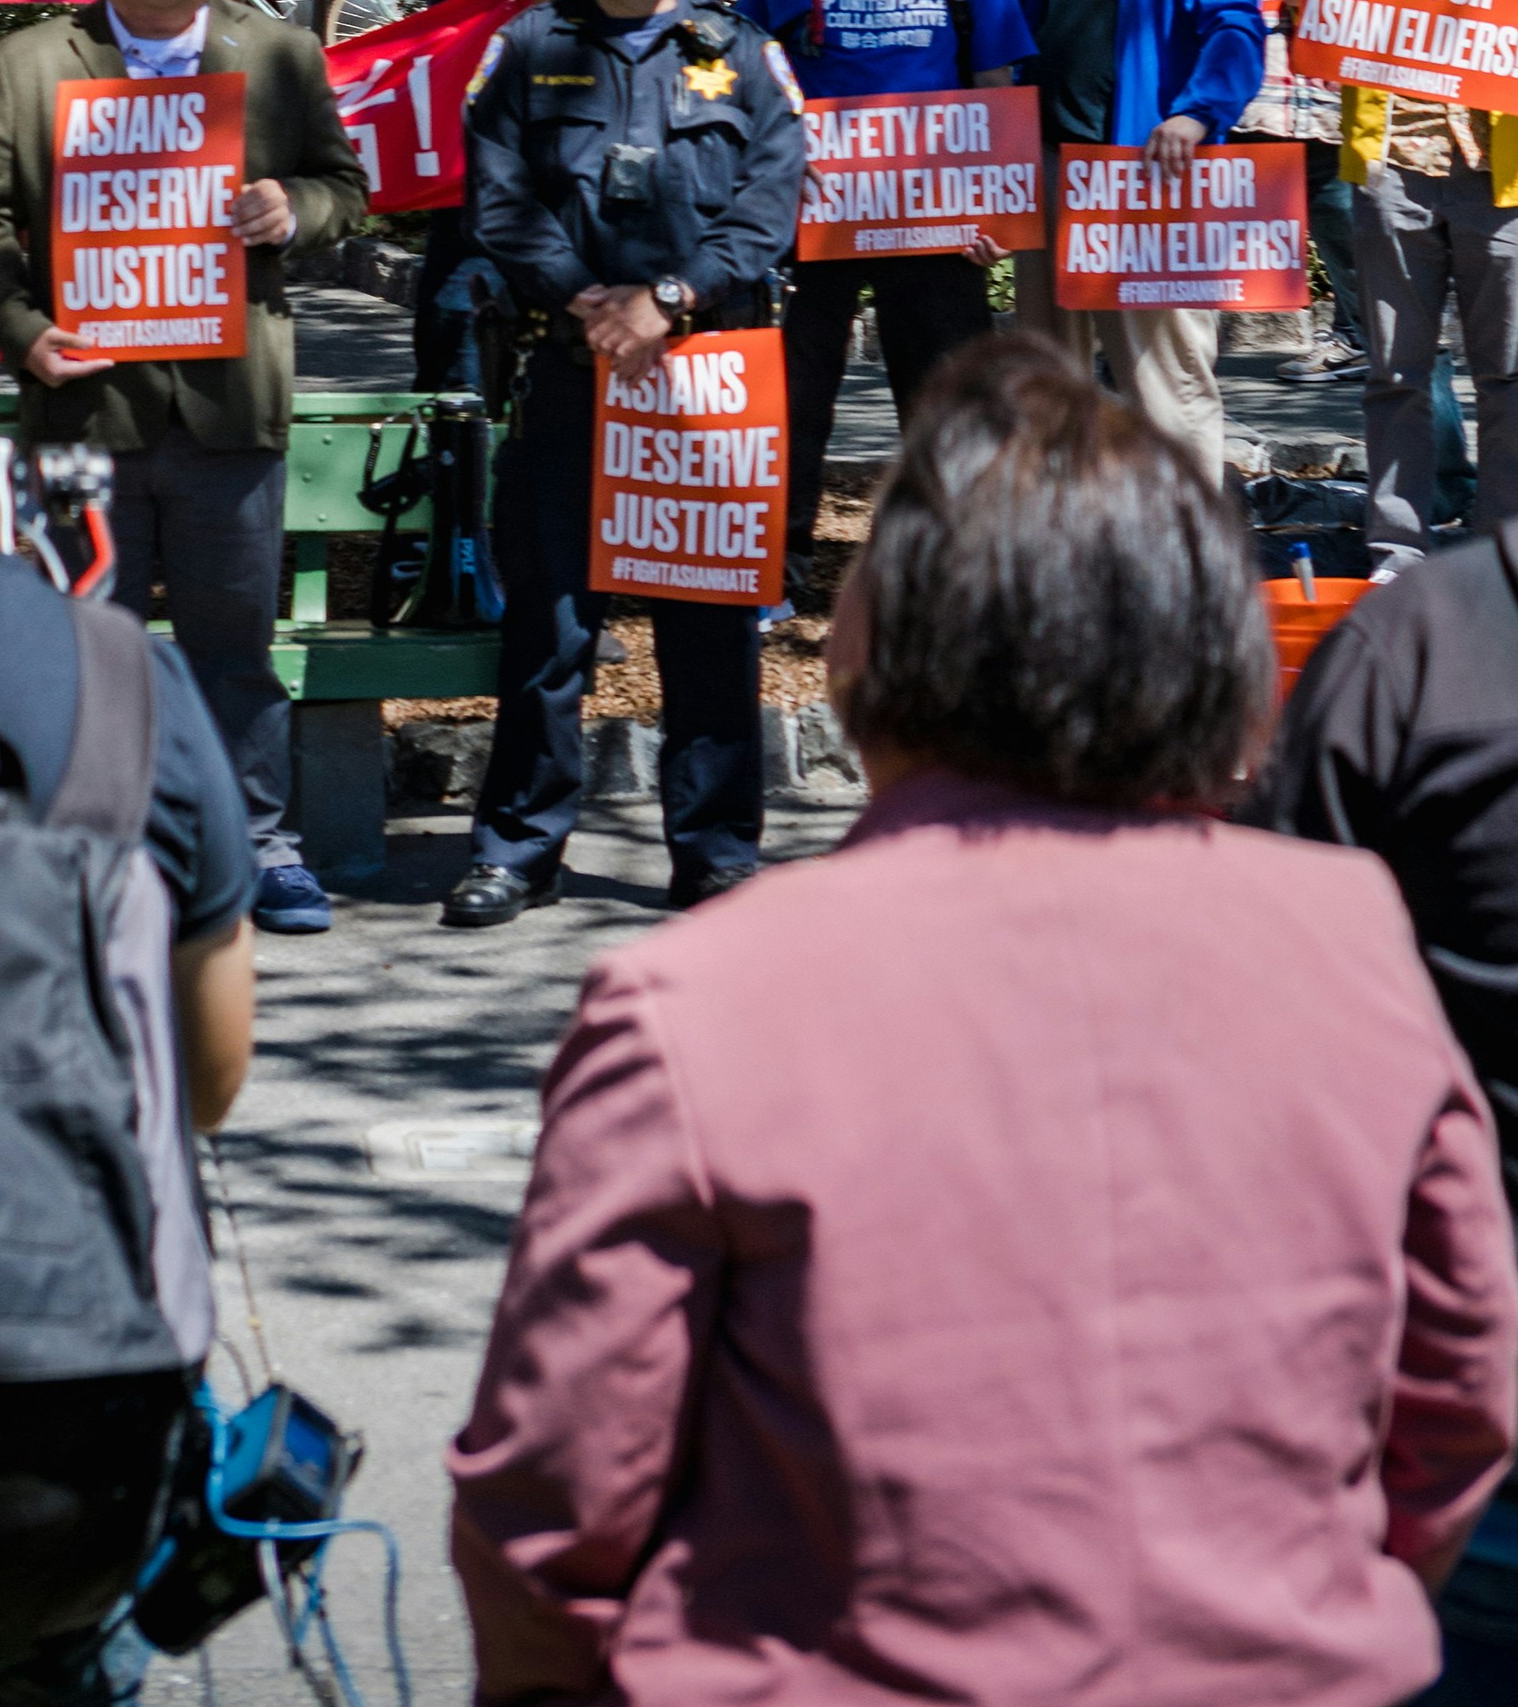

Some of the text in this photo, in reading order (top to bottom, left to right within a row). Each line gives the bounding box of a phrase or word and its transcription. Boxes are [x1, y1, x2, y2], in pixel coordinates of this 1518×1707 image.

[826, 10, 949, 29] COLLABORATIVE
[63, 92, 207, 158] ASIANS
[804, 102, 992, 162] SAFETY FOR
[62, 164, 236, 233] DESERVE
[800, 162, 1037, 224] ASIAN ELDERS!
[1066, 157, 1257, 210] SAFETY FOR
[63, 242, 230, 311] JUSTICE
[1067, 219, 1302, 274] ASIAN ELDERS!
[603, 420, 781, 488] DESERVE
[601, 492, 769, 560] JUSTICE
[612, 556, 760, 593] #FIGHTASIANHATE
